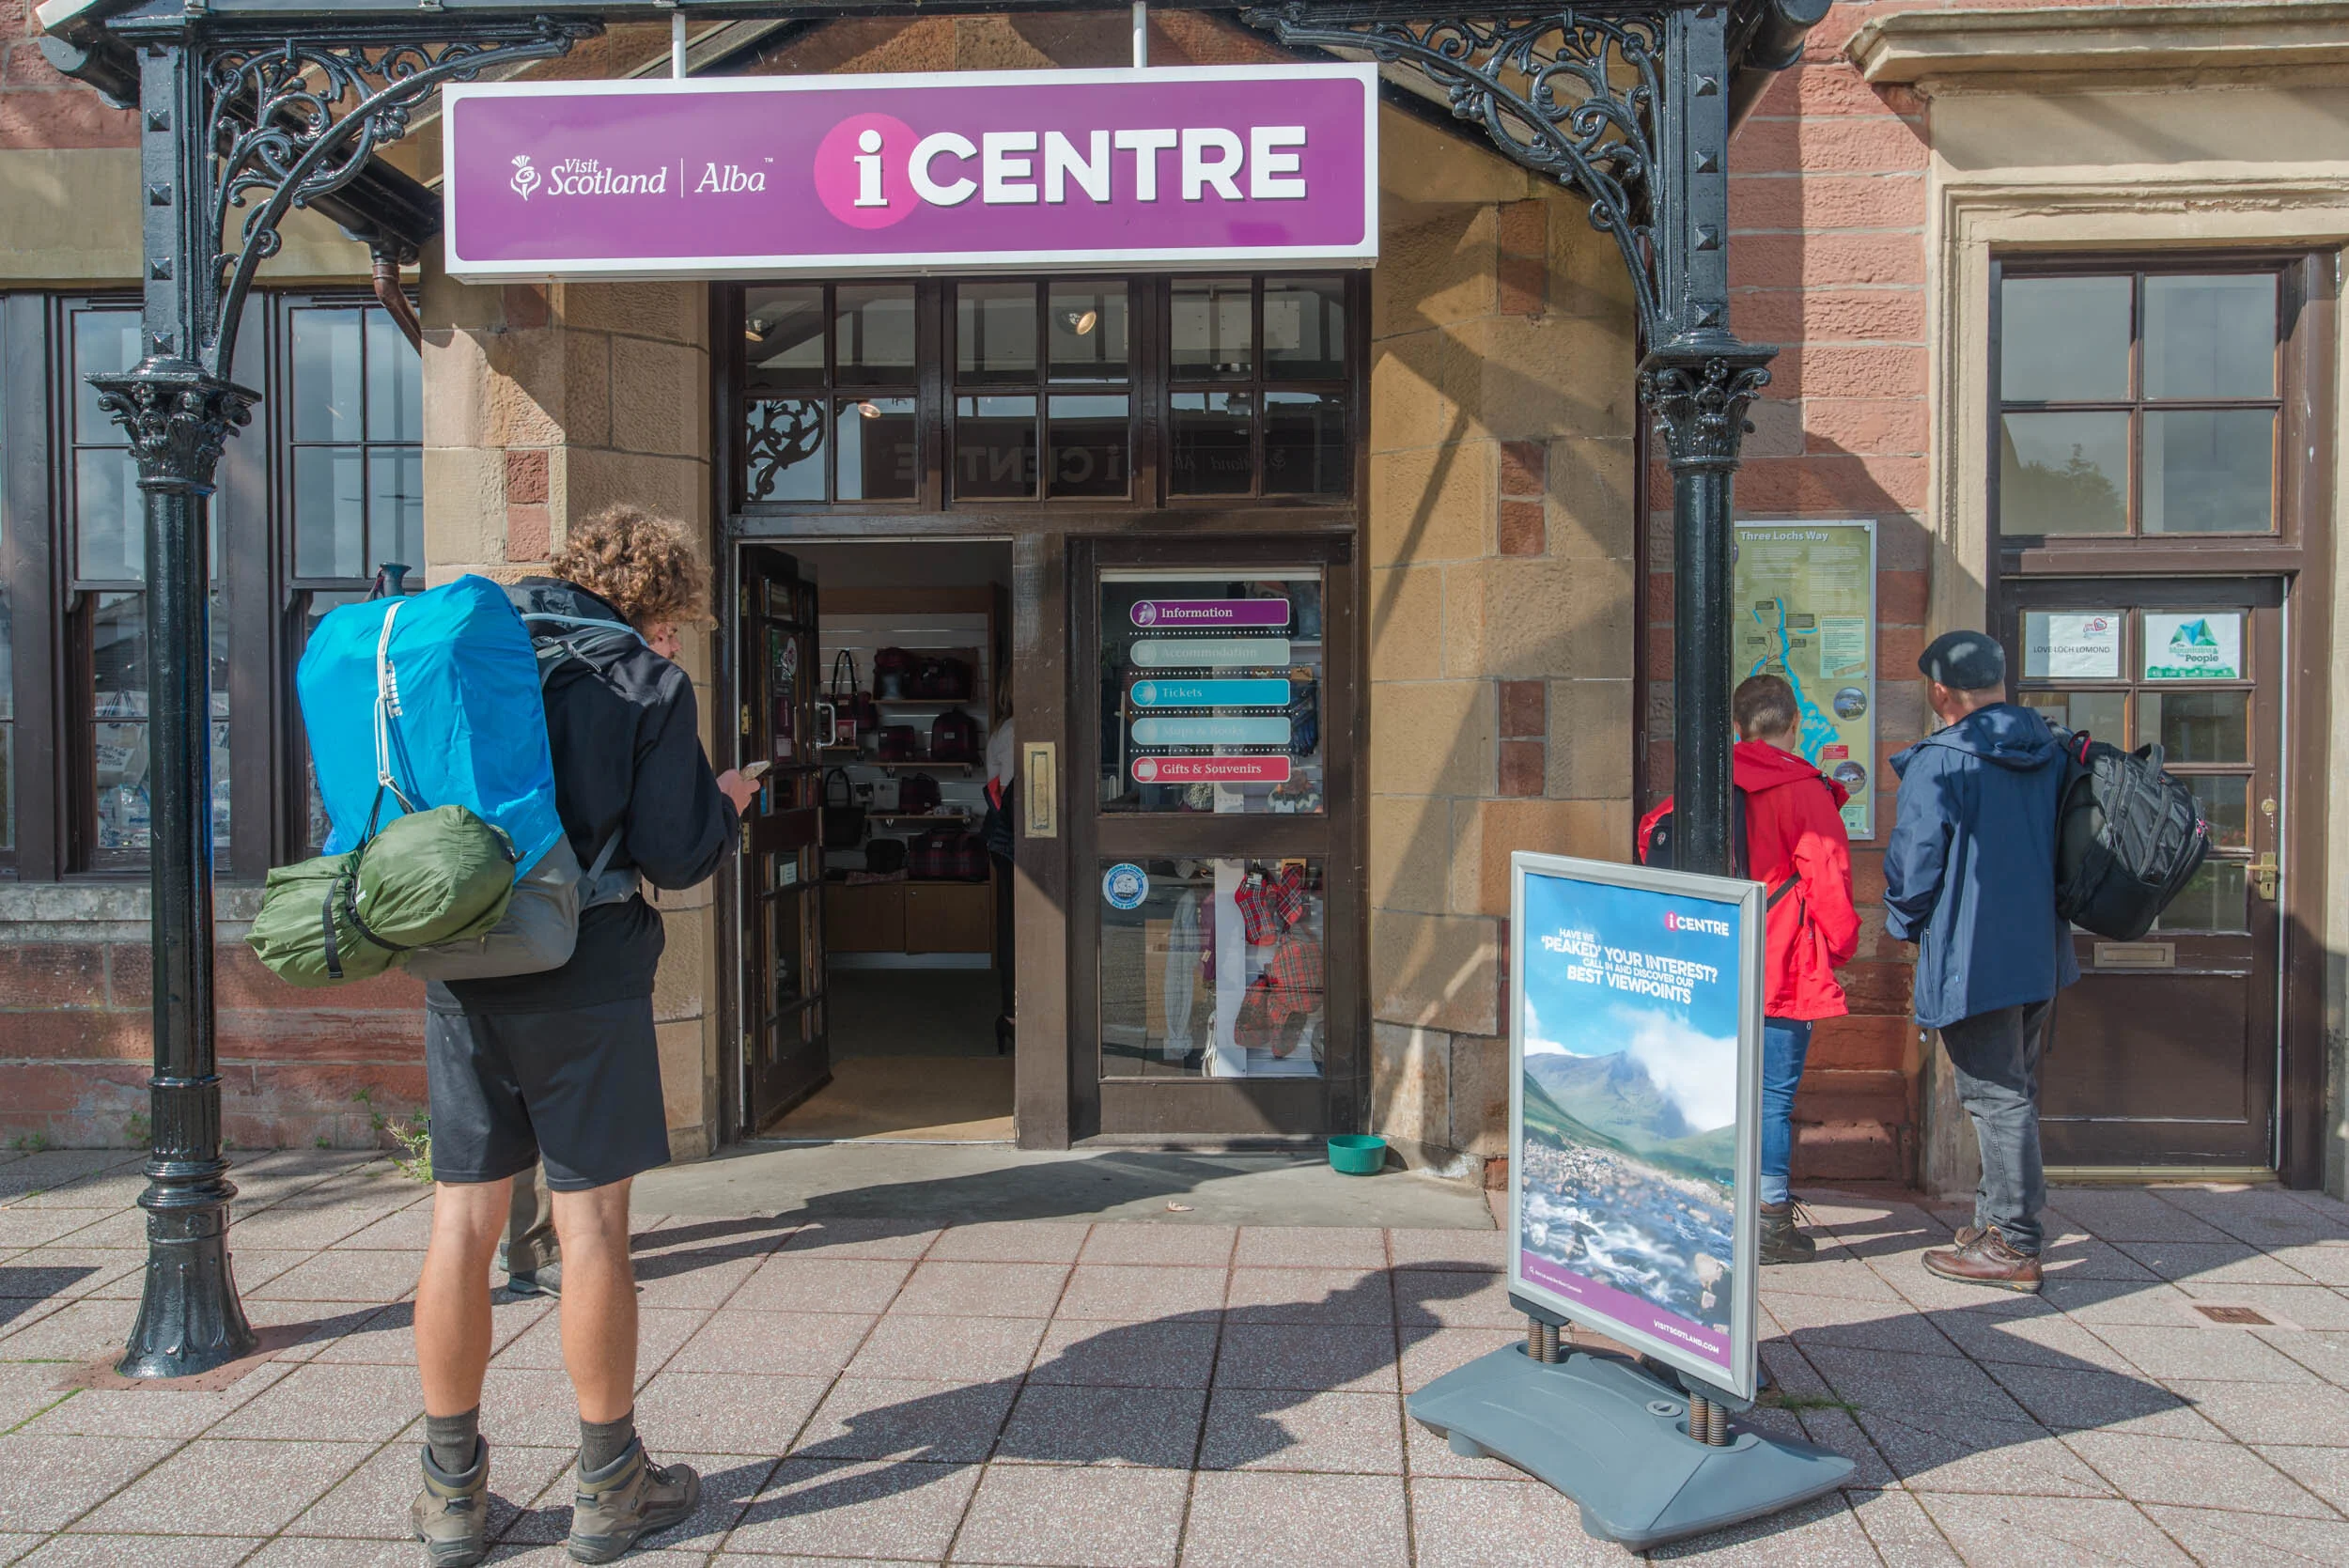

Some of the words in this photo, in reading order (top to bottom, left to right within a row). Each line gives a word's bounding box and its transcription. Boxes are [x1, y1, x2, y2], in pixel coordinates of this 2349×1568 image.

[565, 158, 599, 173] Visit
[854, 130, 888, 207] i
[908, 126, 1307, 206] CENTRE
[548, 164, 668, 195] Scotland
[694, 163, 766, 194] Alba
[1740, 531, 1771, 541] Three
[1774, 531, 1804, 541] Lochs
[1806, 531, 1829, 542] Way
[1161, 607, 1233, 619] Information
[2033, 645, 2050, 654] LOVE
[2054, 645, 2074, 654] LOCH
[2077, 645, 2109, 654] LOMOND
[2186, 654, 2219, 663] People
[1163, 687, 1203, 698] Tickets
[1162, 764, 1190, 775] Gifts
[1192, 764, 1202, 775] &
[1206, 763, 1262, 775] Souvenirs
[1676, 916, 1730, 937] CENTRE
[1560, 928, 1580, 940] HAVE
[1583, 932, 1595, 943] WE
[1604, 946, 1642, 968] YOUR
[1645, 955, 1719, 984] INTEREST?
[1582, 958, 1603, 970] CALL
[1605, 962, 1613, 971] IN
[1614, 964, 1631, 976] AND
[1633, 967, 1674, 984] DISCOVER
[1676, 976, 1694, 988] OUR
[1567, 966, 1603, 986] BEST
[1606, 972, 1692, 1005] VIEWPOINTS
[1653, 1319, 1719, 1354] VISITSCOTLAND.COM
